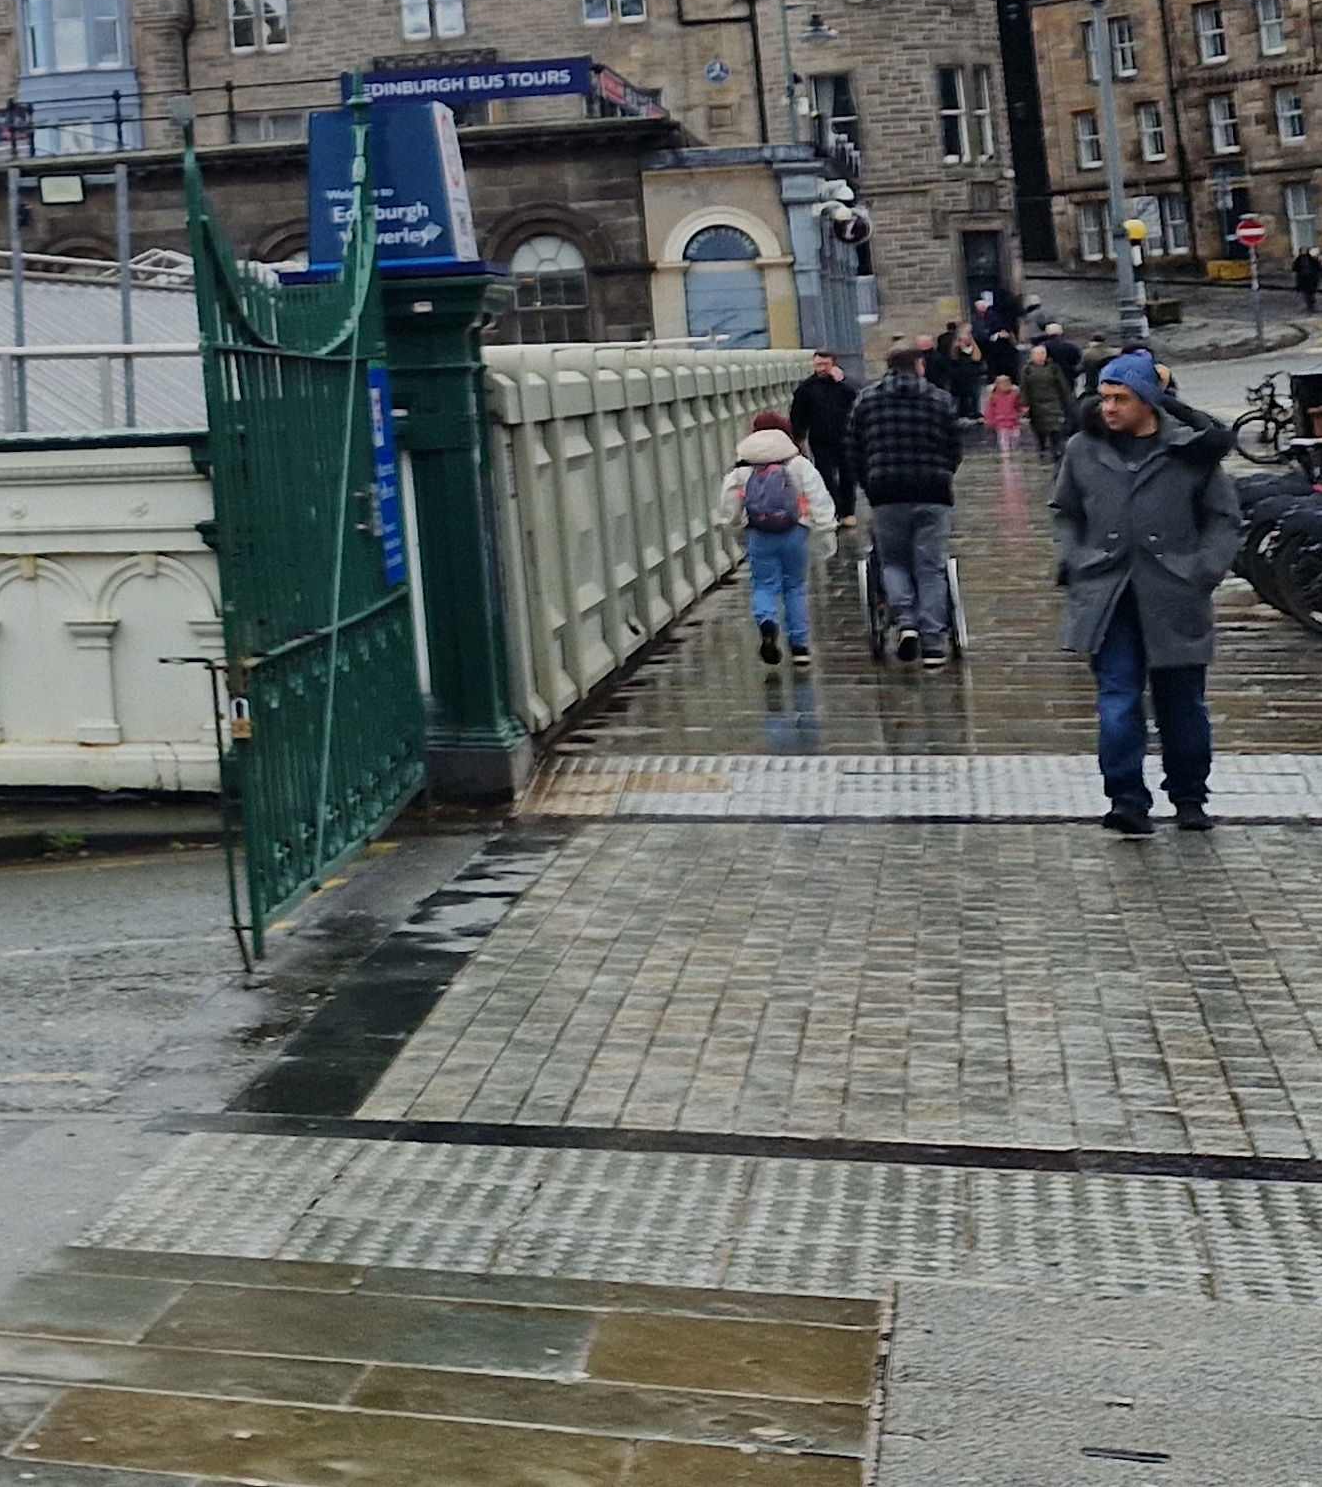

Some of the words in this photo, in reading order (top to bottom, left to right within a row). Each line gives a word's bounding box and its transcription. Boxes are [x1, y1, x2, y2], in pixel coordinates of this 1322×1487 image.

[362, 77, 465, 98] EDINBURGH
[468, 73, 505, 90] BUS
[507, 68, 571, 88] TOURS
[332, 201, 429, 223] Edburgh
